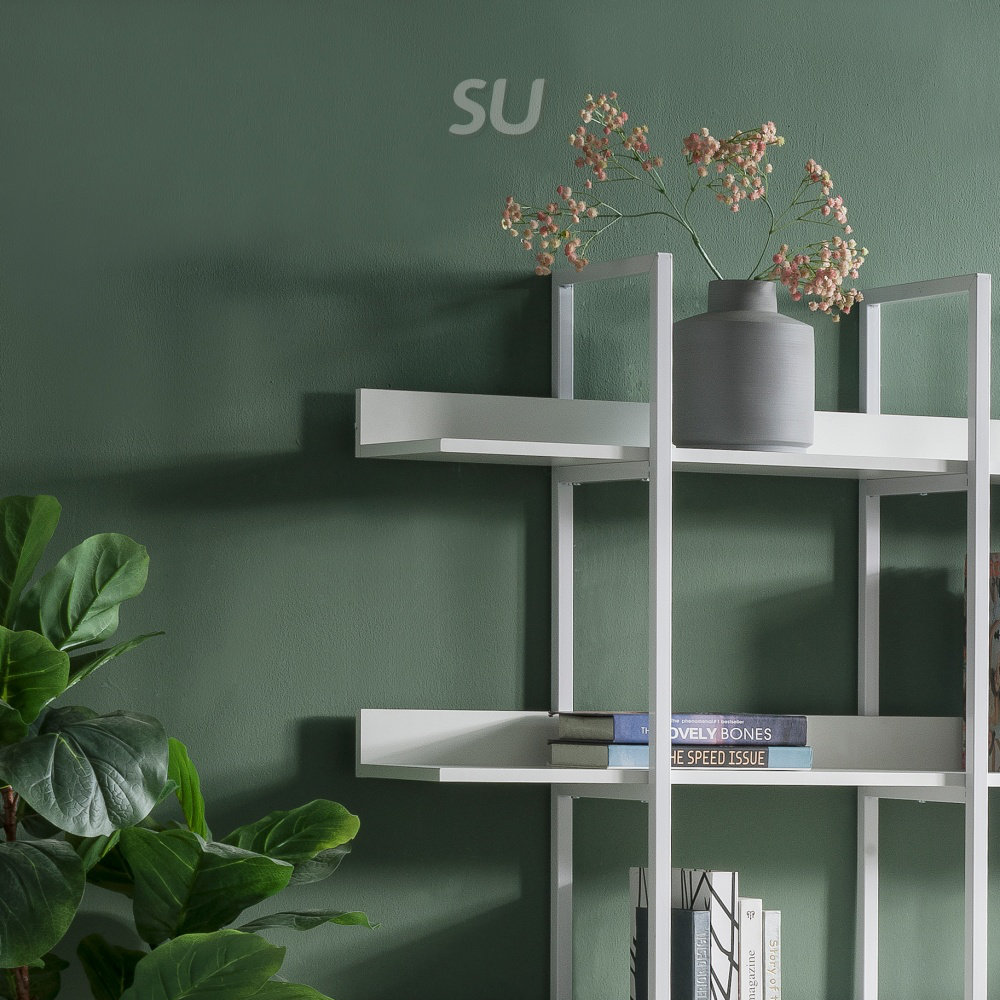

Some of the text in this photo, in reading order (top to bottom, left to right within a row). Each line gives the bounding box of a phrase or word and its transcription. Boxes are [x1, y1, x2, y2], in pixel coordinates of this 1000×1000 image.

[671, 727, 718, 740] OVELY
[721, 727, 772, 741] BONES
[671, 750, 765, 766] HE SPEED ISSUE
[767, 940, 778, 975] Story
[769, 979, 779, 991] of
